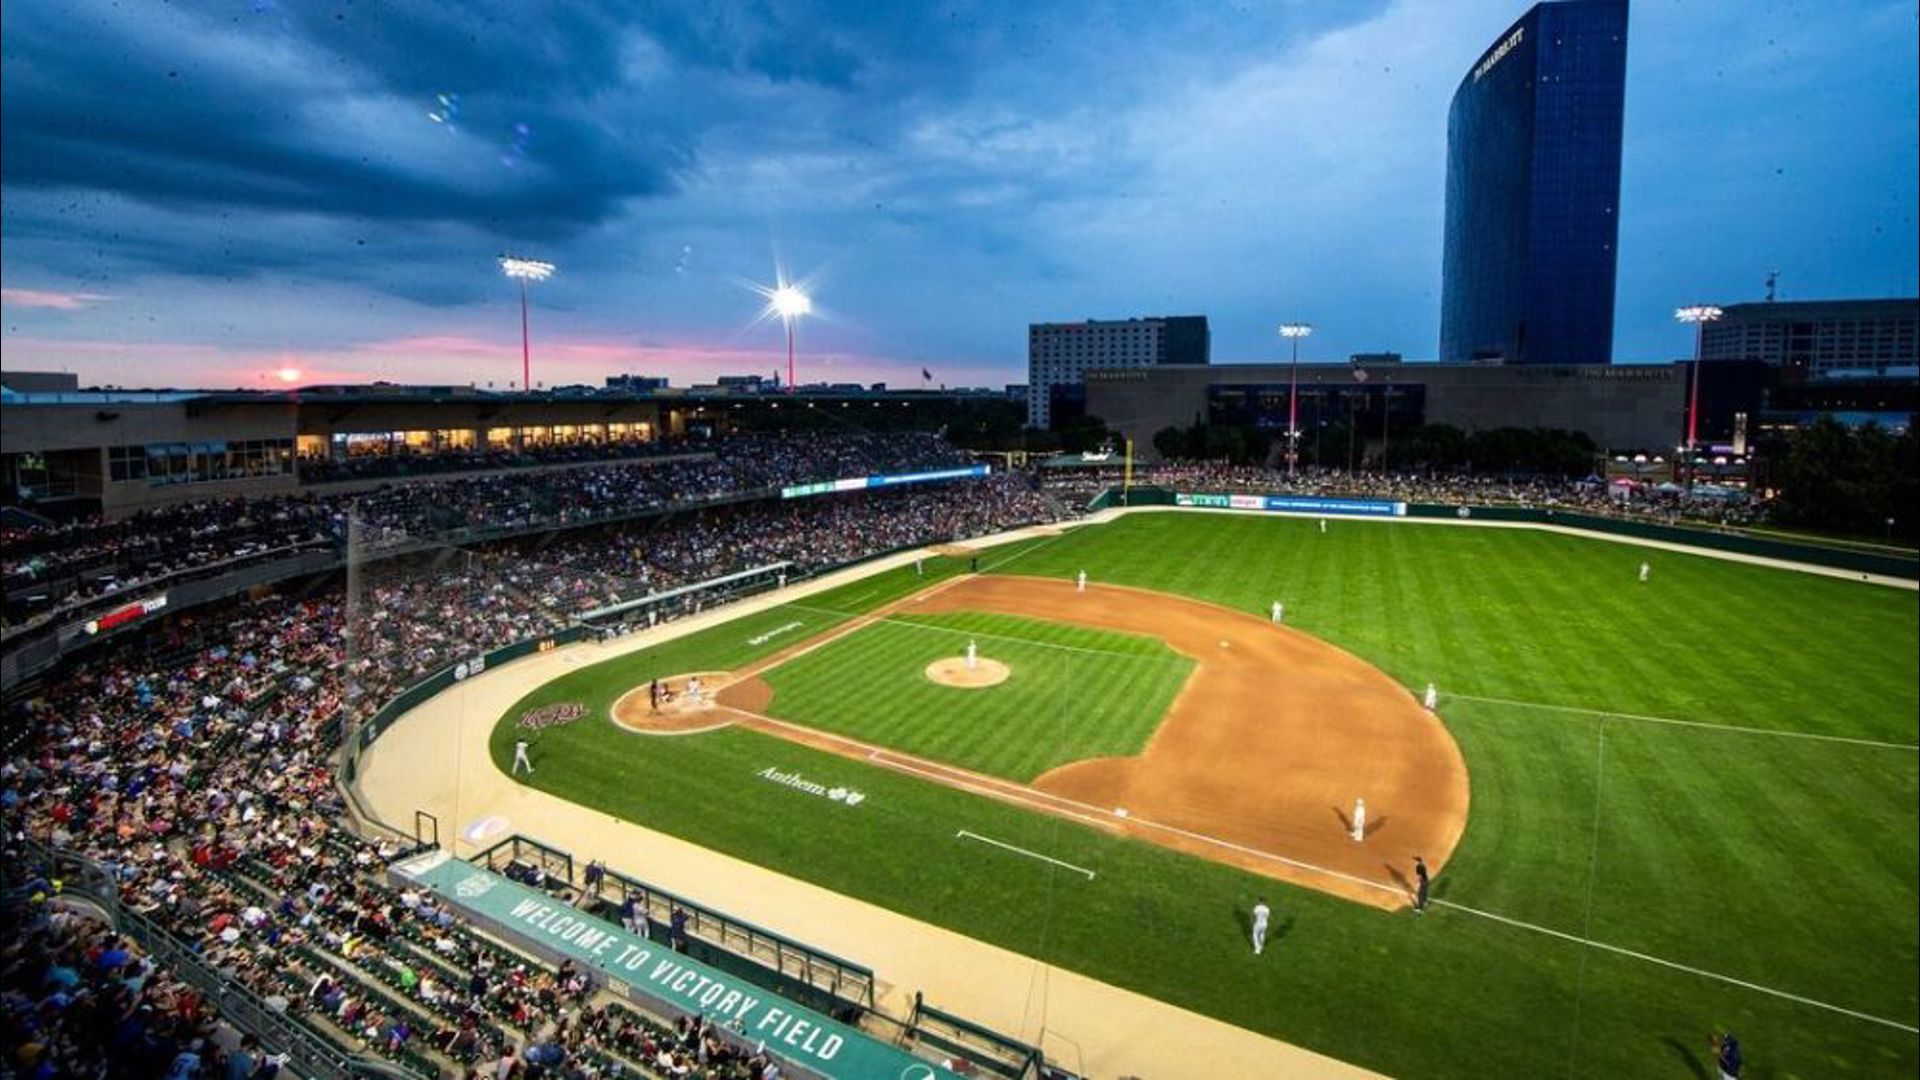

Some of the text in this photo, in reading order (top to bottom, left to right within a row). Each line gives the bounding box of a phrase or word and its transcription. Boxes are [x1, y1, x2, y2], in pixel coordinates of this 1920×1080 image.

[757, 766, 825, 796] Anthem
[510, 897, 845, 1061] WELCOME TO VICTORY FIELD
